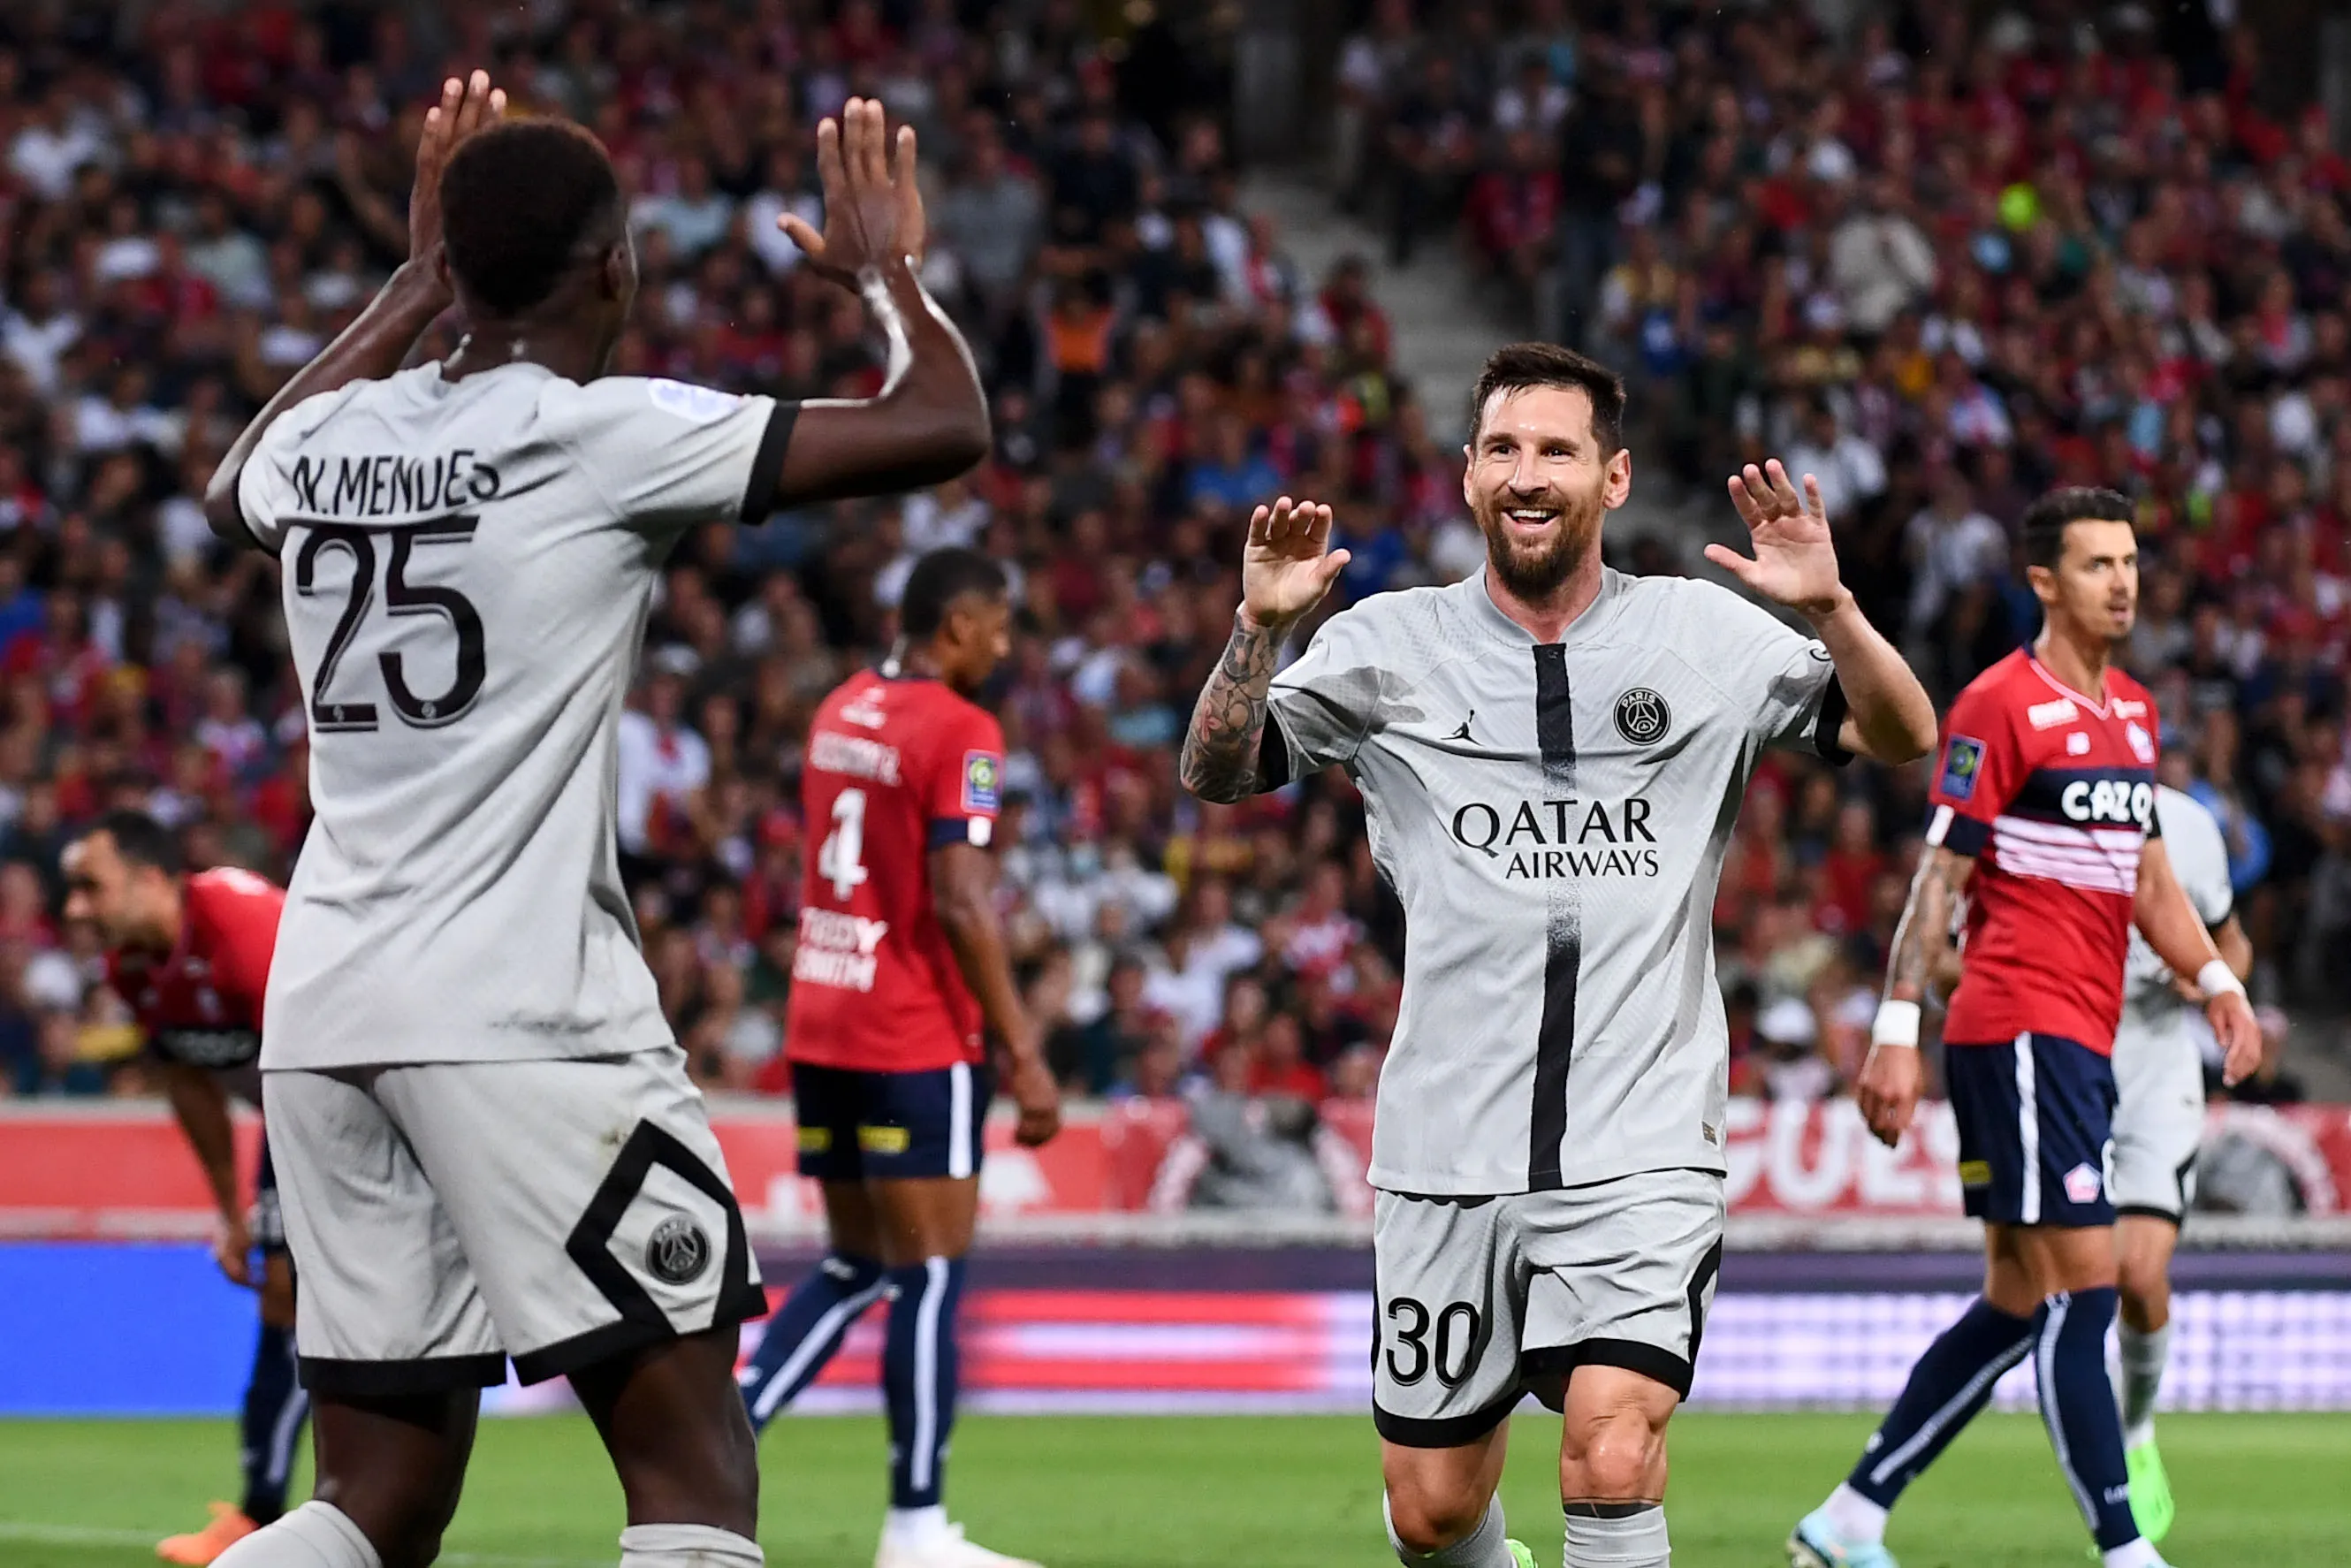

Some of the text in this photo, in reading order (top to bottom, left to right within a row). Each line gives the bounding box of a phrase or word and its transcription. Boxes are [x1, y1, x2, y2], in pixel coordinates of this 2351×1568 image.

[296, 514, 487, 734] 25
[1621, 691, 1656, 708] PARIS
[1452, 798, 1658, 858] QATAR
[1505, 849, 1659, 879] AIRWAYS
[1386, 1297, 1480, 1389] 30
